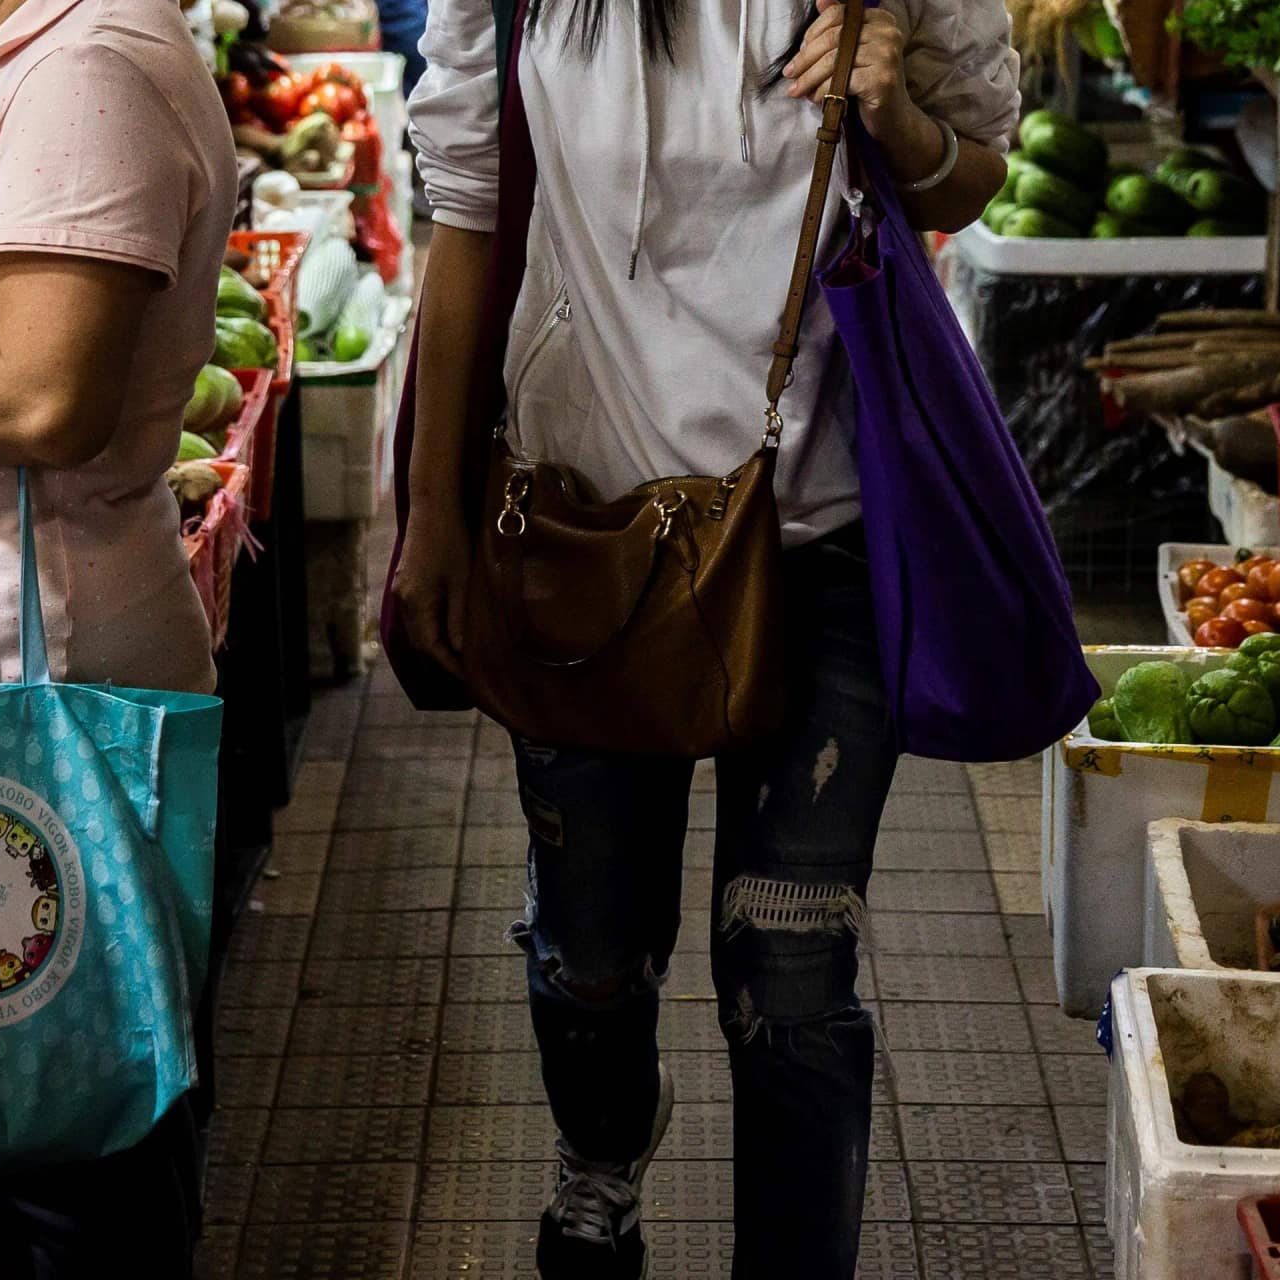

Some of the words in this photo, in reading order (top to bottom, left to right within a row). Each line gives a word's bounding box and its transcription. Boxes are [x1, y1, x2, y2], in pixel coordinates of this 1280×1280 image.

[38, 807, 70, 857] VIGOR
[62, 860, 81, 911] KOBO
[22, 972, 61, 1008] KOBO
